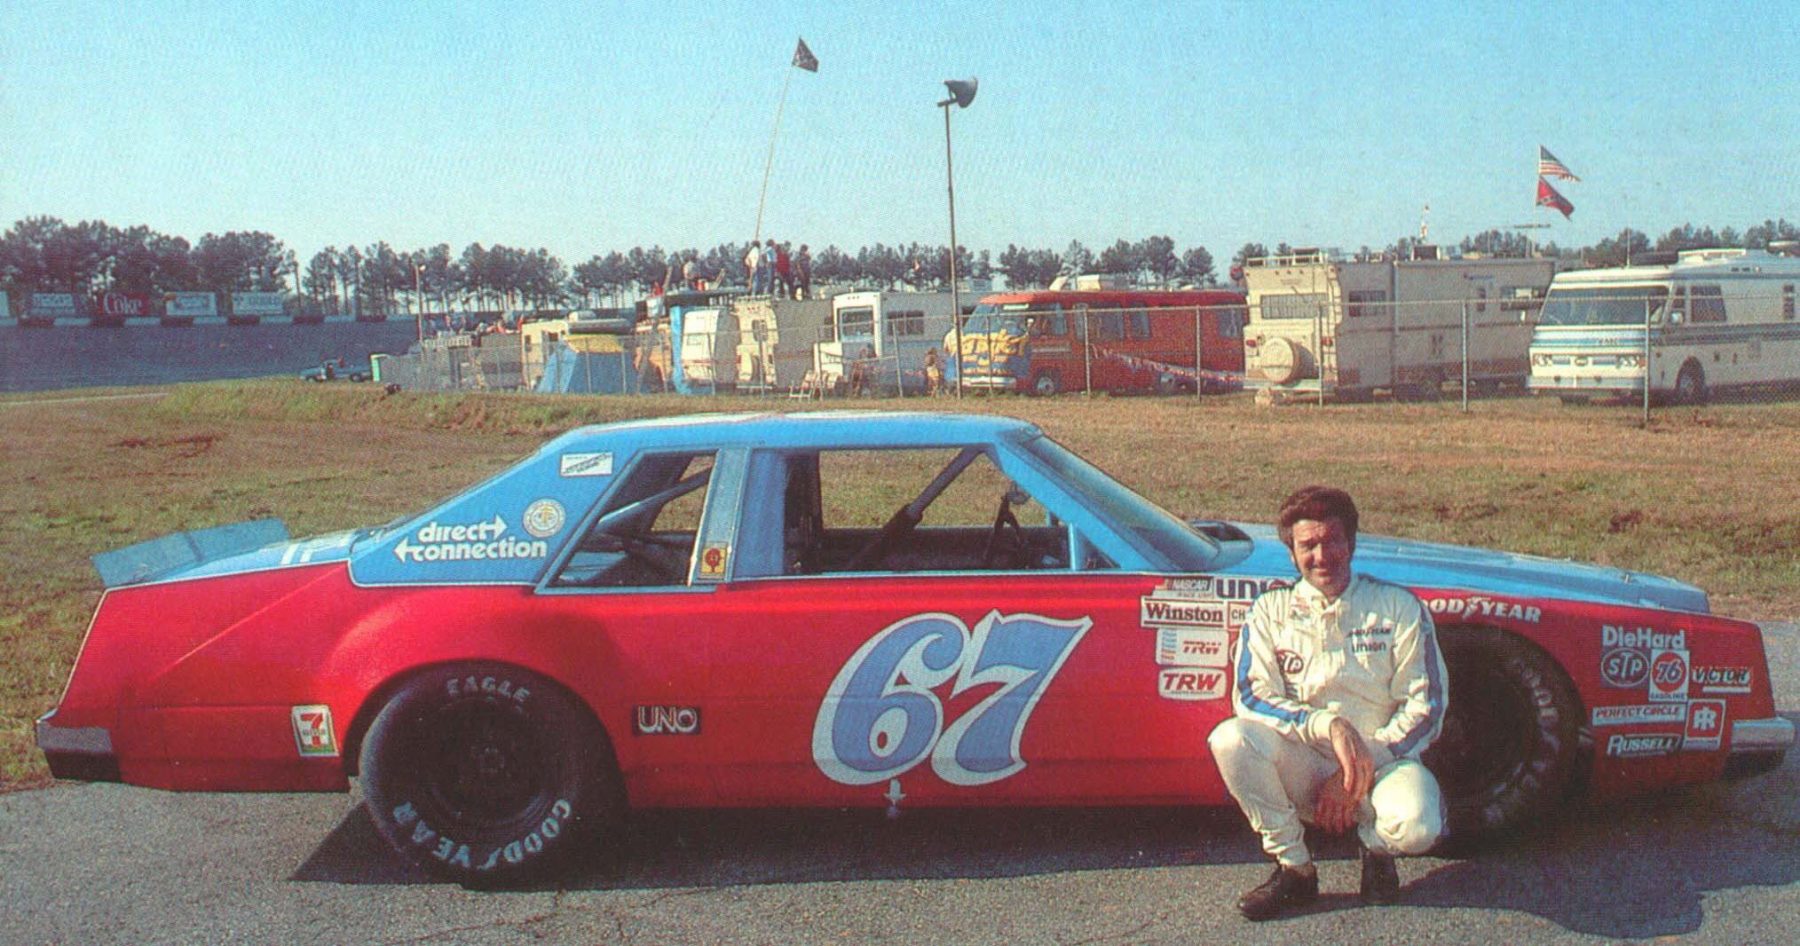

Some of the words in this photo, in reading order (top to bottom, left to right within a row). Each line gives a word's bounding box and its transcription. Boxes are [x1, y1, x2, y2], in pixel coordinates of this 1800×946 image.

[103, 292, 143, 314] Coke
[417, 521, 491, 543] direct
[410, 538, 547, 562] connection
[1145, 602, 1224, 622] Winston
[1422, 596, 1541, 623] ODYEAR
[1184, 641, 1221, 654] TRW
[1602, 625, 1685, 649] DieHard
[1608, 651, 1643, 679] STP
[1655, 659, 1683, 684] 76
[447, 675, 531, 702] EAGLE
[1163, 673, 1222, 690] TRW
[812, 609, 1093, 786] 67
[638, 706, 697, 733] UNO
[1607, 735, 1675, 756] RUSSELL
[393, 799, 572, 870] GOODYEAR
